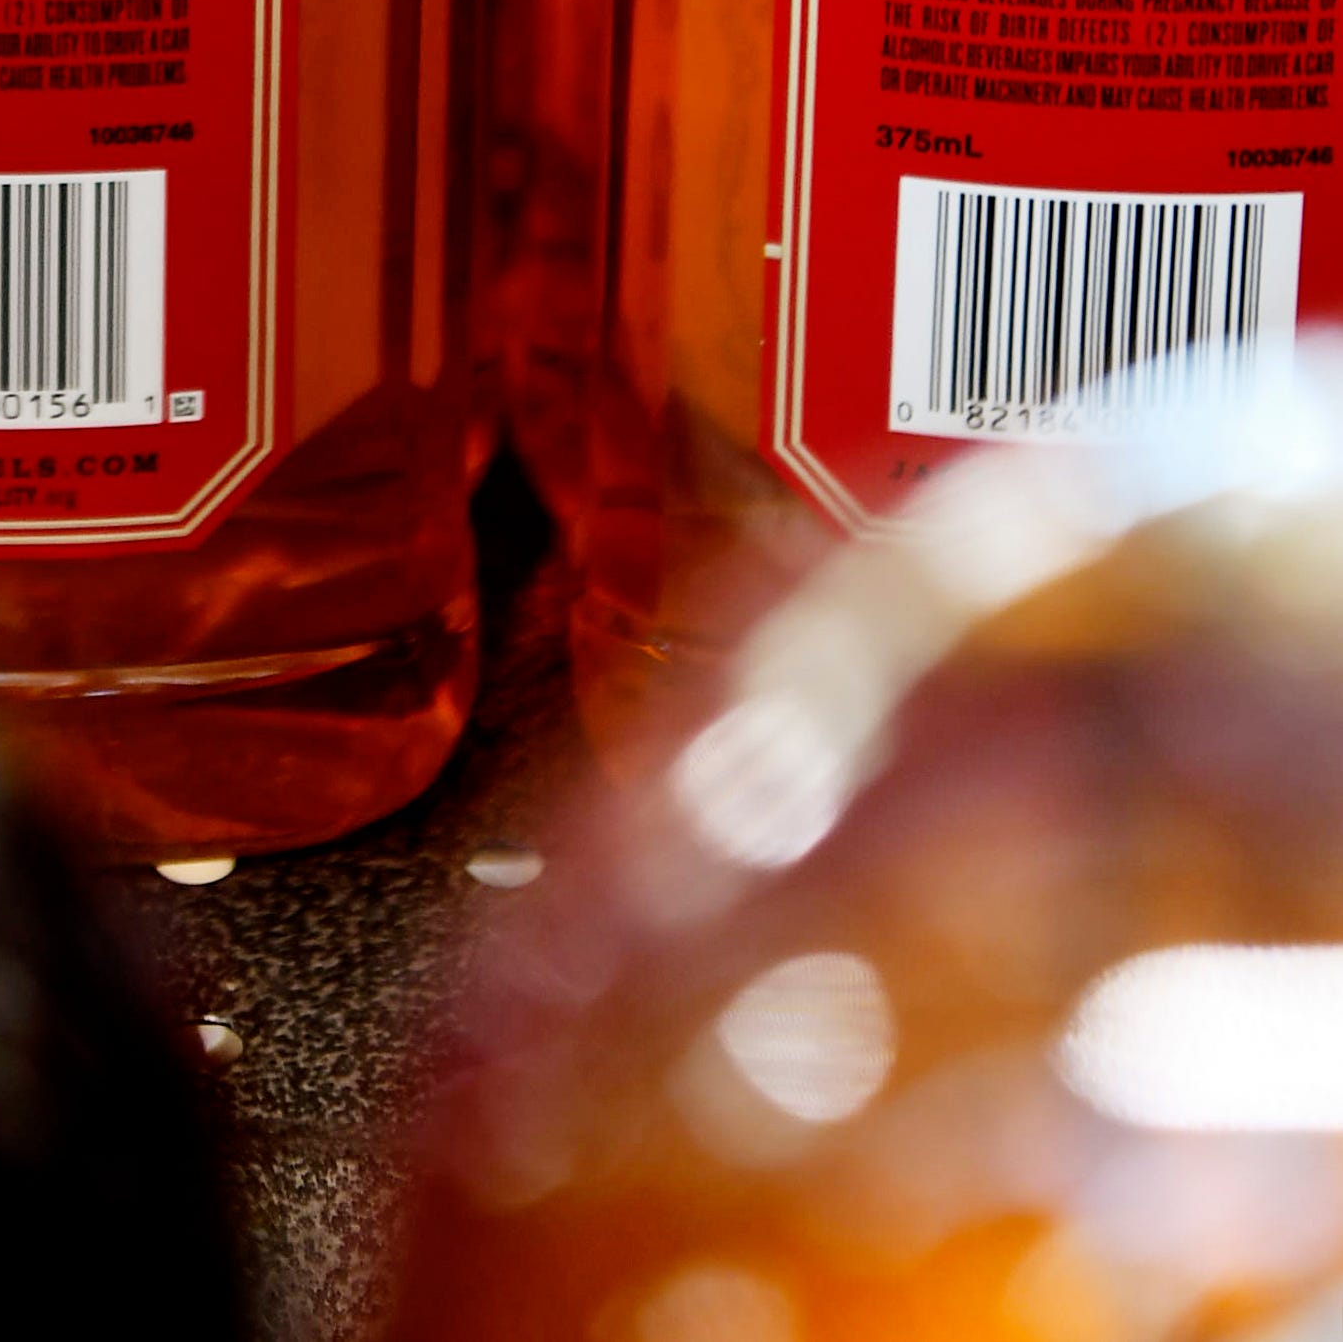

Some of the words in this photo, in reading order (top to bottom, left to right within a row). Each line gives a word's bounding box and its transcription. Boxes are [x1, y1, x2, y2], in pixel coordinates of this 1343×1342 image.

[884, 1, 912, 29] THE
[969, 10, 988, 36] OF
[1187, 19, 1308, 47] CONSUMPTION
[1317, 18, 1335, 44] OF
[966, 42, 1052, 74] BEVERAGES
[876, 126, 983, 159] 375mL
[1227, 146, 1334, 169] 10036746
[144, 395, 155, 417] 1
[896, 402, 913, 423] 0
